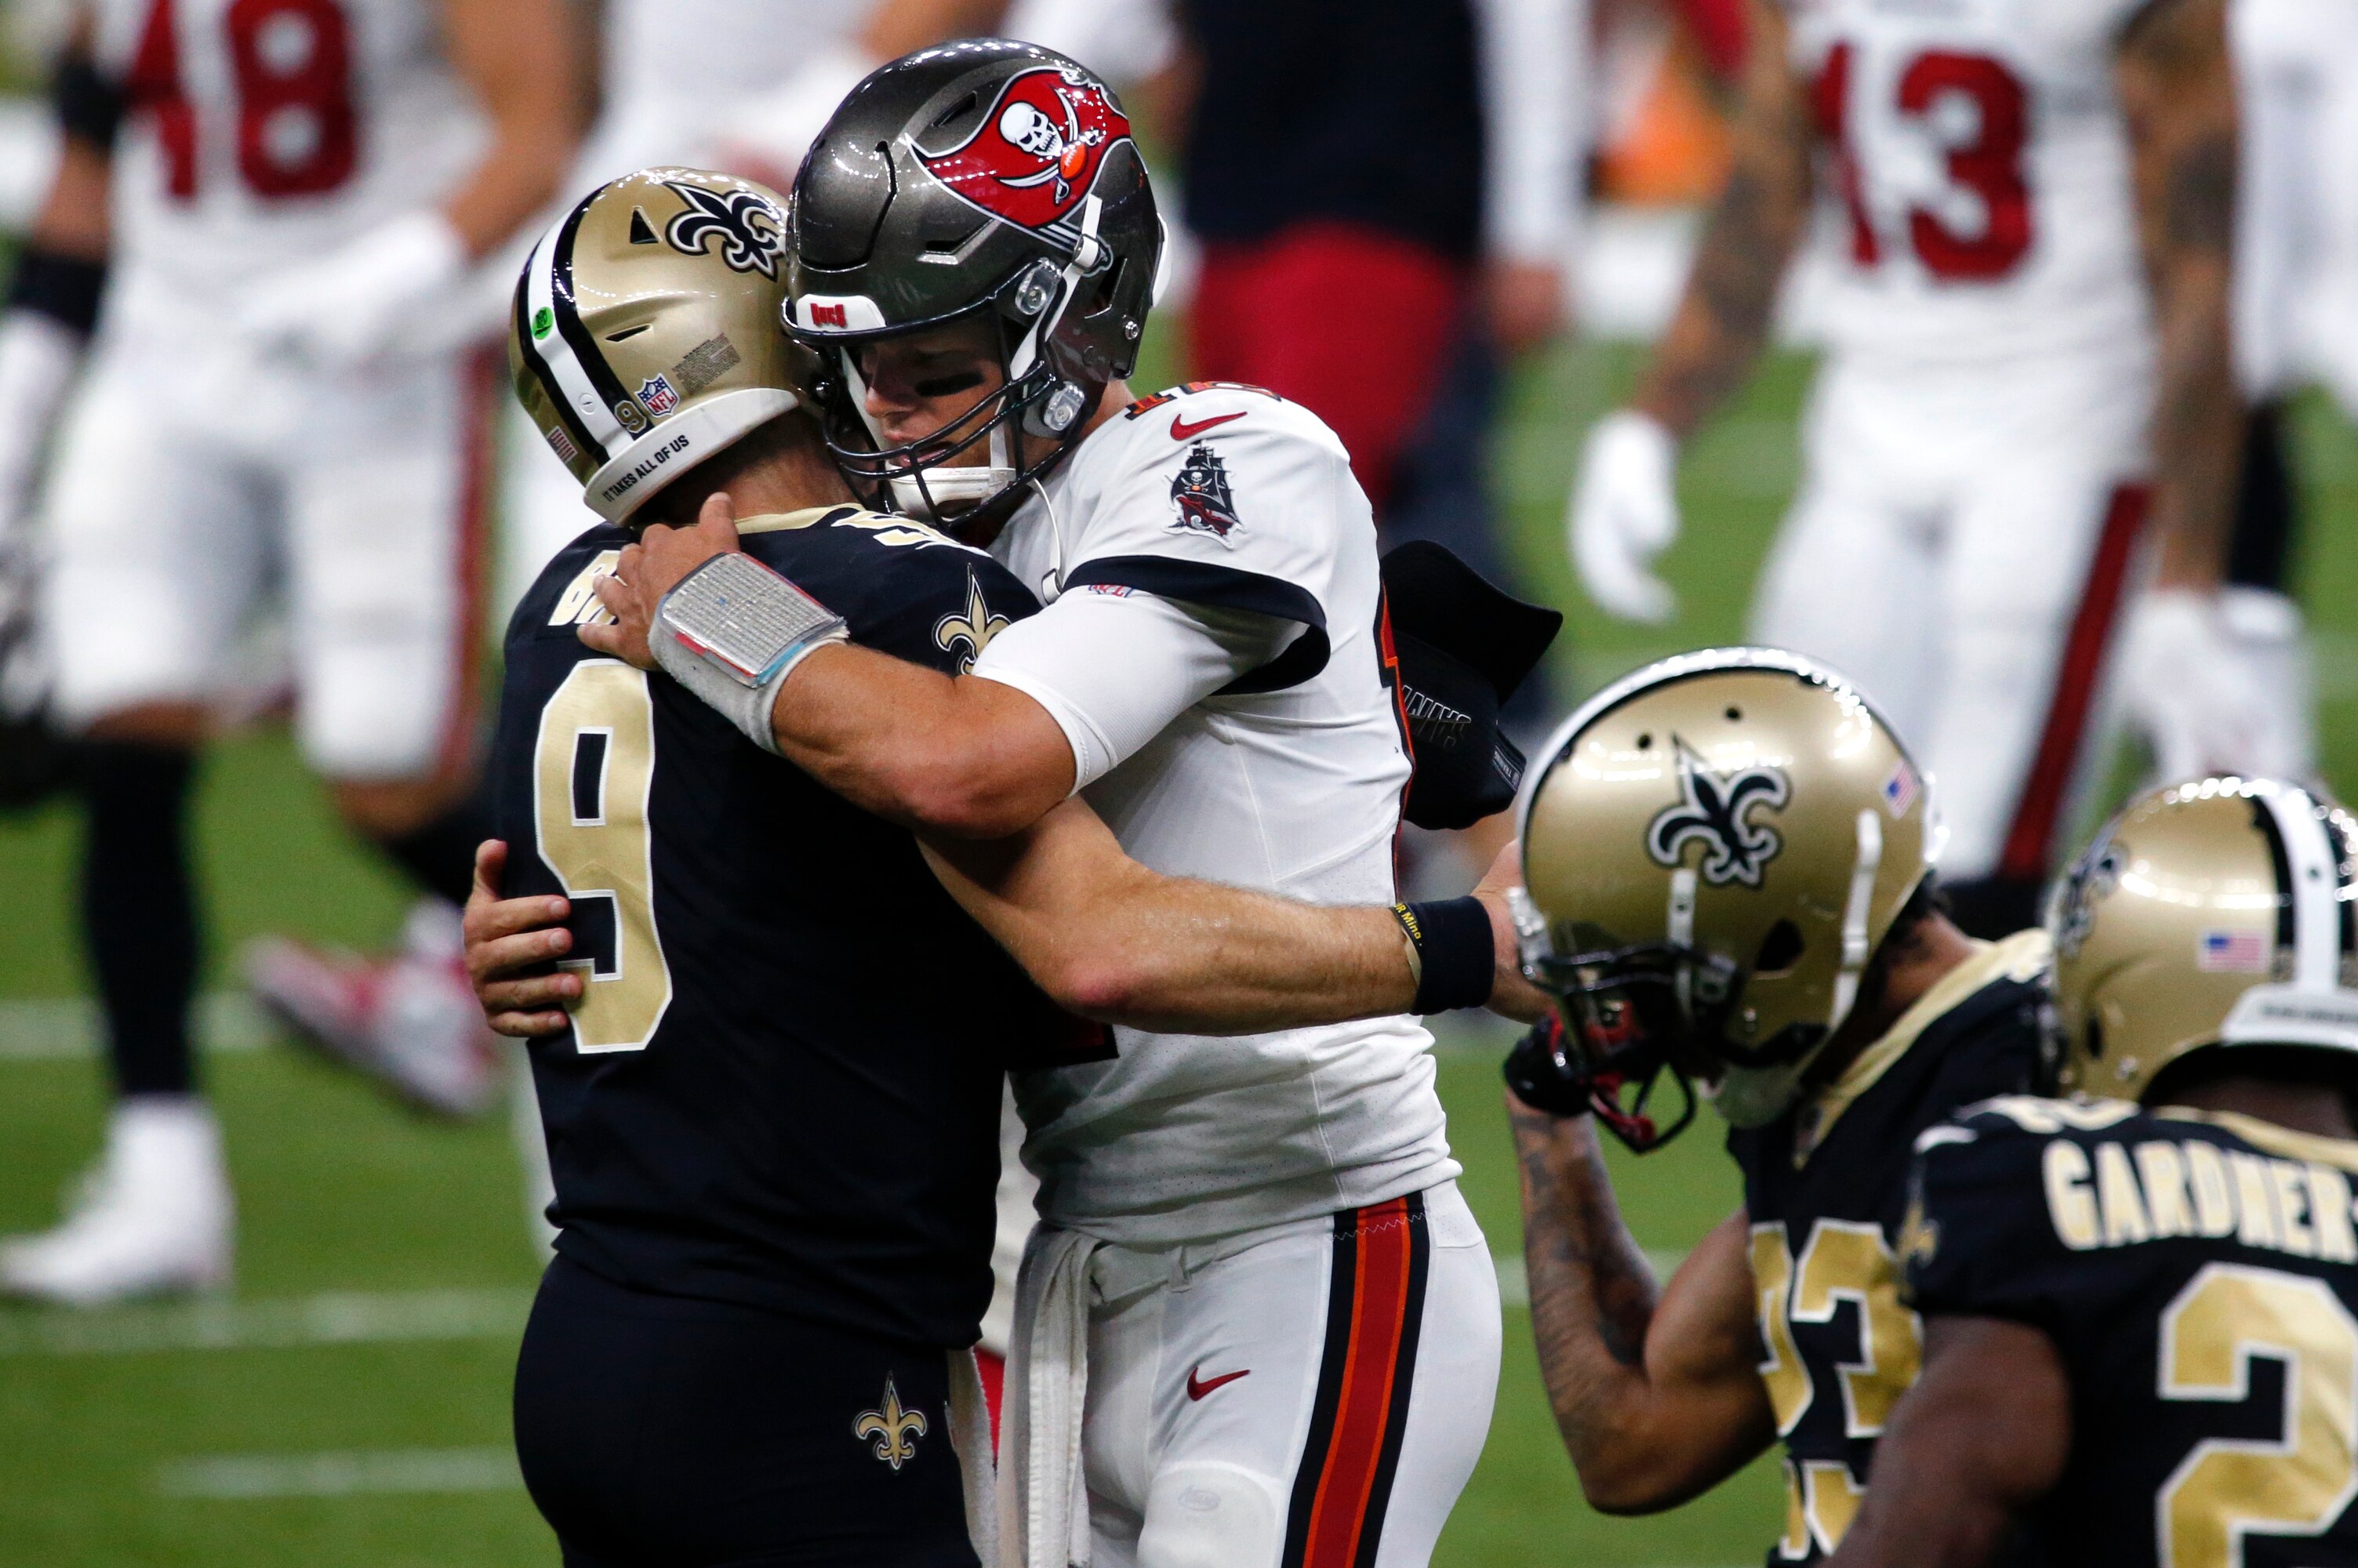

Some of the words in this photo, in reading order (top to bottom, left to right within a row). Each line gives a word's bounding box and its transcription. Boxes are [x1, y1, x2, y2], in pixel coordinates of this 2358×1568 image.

[648, 390, 676, 413] NFL
[614, 400, 647, 434] 9
[669, 434, 690, 452] US
[654, 446, 670, 464] OF
[634, 459, 658, 479] ALL
[608, 473, 638, 497] TAKES
[602, 490, 616, 503] IT
[534, 658, 673, 1054] 9
